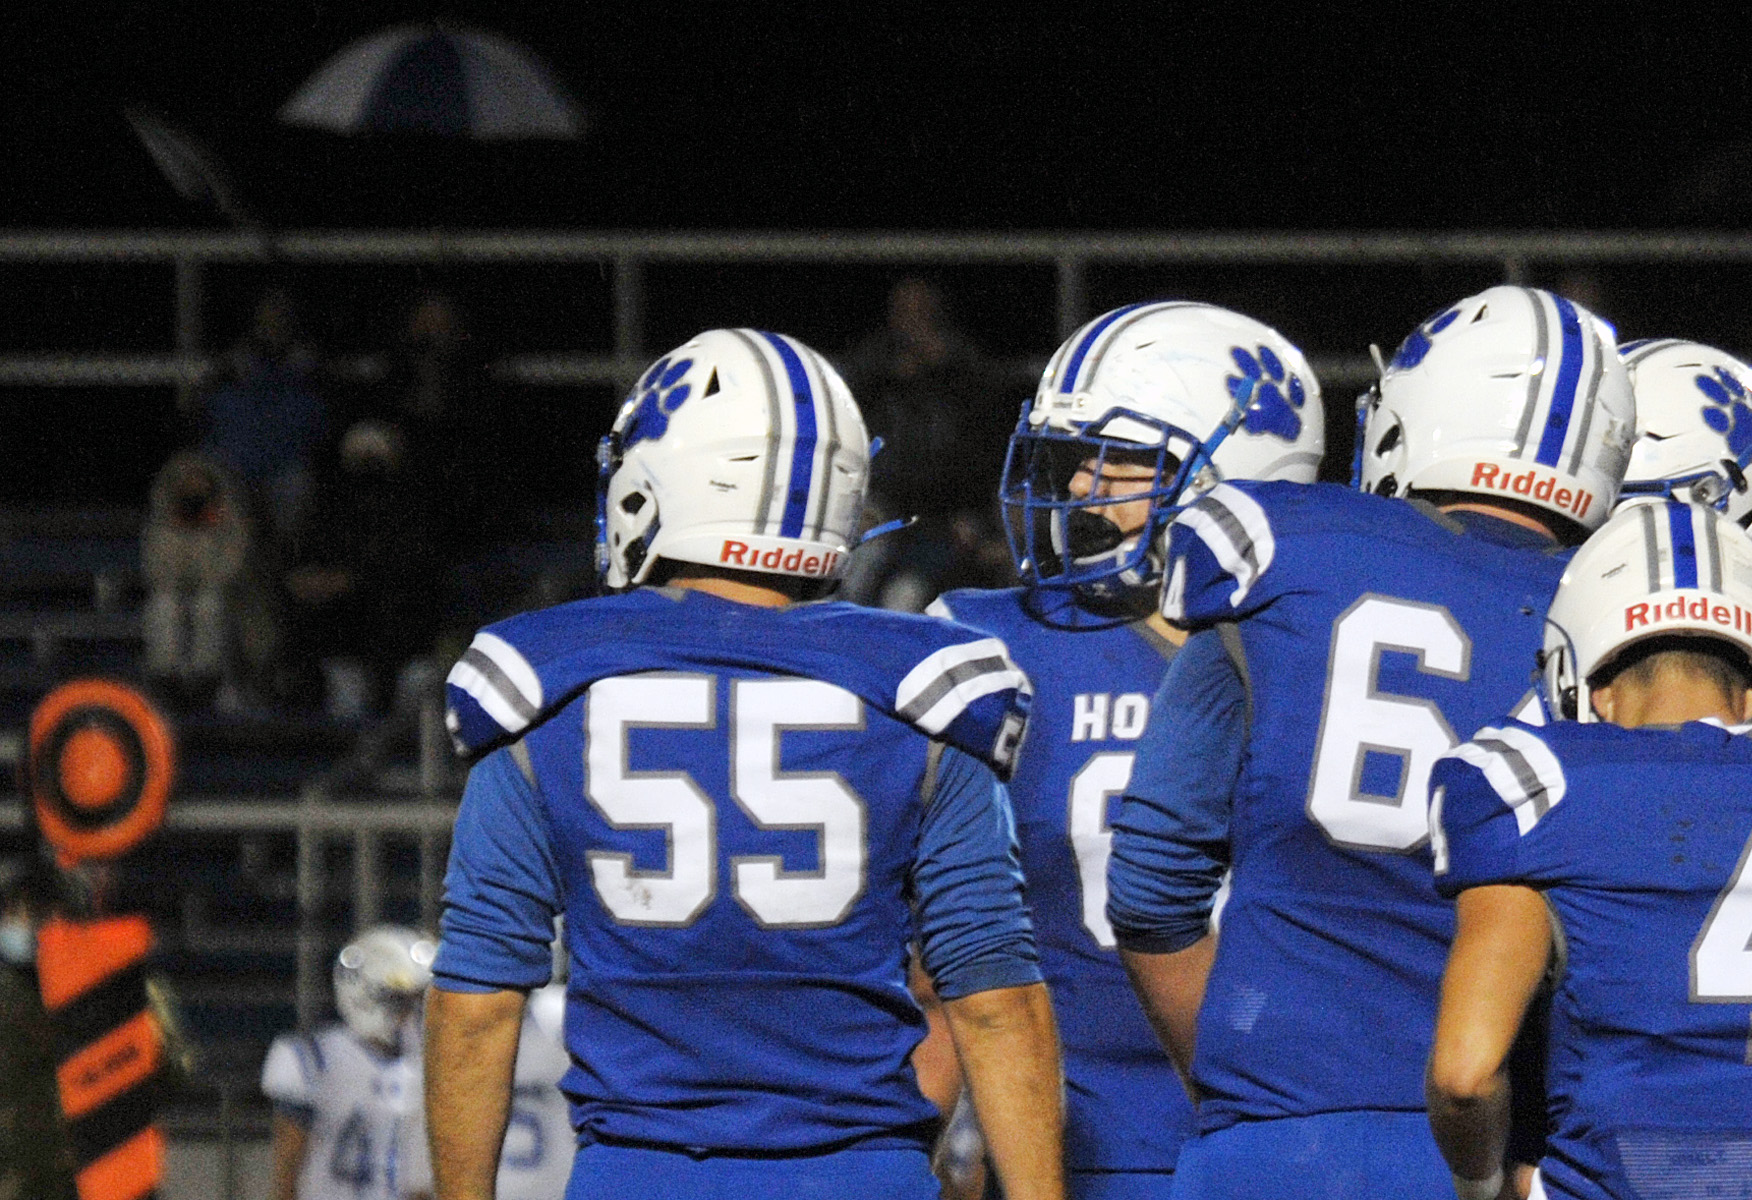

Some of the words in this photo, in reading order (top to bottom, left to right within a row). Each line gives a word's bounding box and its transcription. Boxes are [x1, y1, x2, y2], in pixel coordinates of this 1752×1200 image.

[1470, 462, 1593, 518] Riddell
[719, 540, 838, 576] Riddell
[1625, 596, 1752, 636] Riddell
[584, 672, 867, 928] 55
